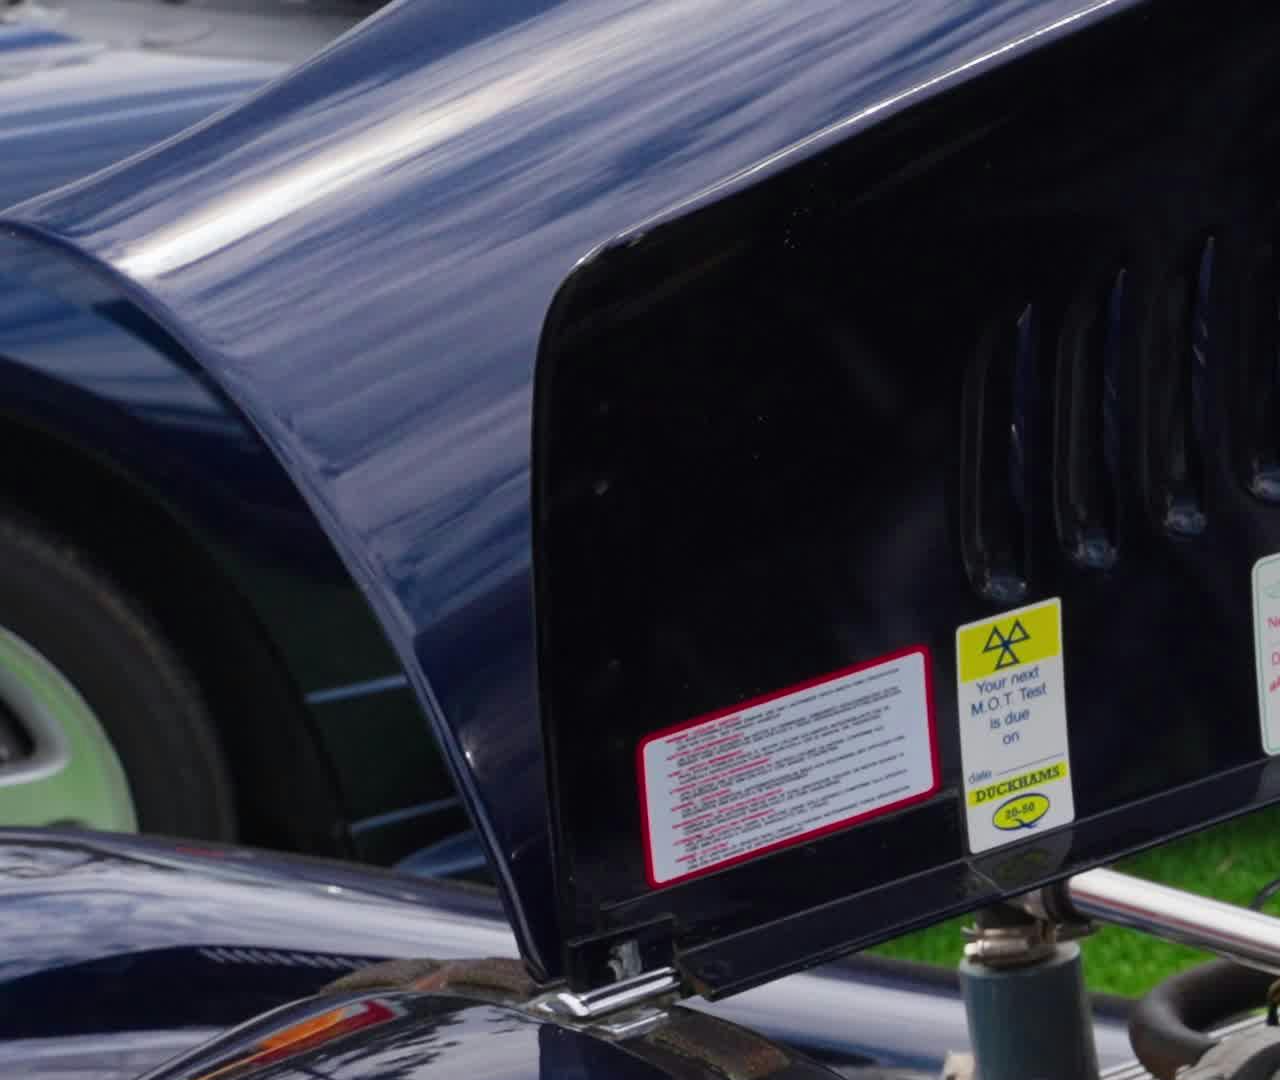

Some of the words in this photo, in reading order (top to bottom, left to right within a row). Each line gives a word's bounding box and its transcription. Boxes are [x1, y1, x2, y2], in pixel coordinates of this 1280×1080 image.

[976, 678, 1007, 696] Your
[1010, 665, 1040, 685] next
[1020, 681, 1048, 701] Test
[990, 716, 1002, 730] is
[1005, 708, 1030, 726] due
[1002, 731, 1020, 745] on
[975, 765, 1061, 803] DUCKHAMS
